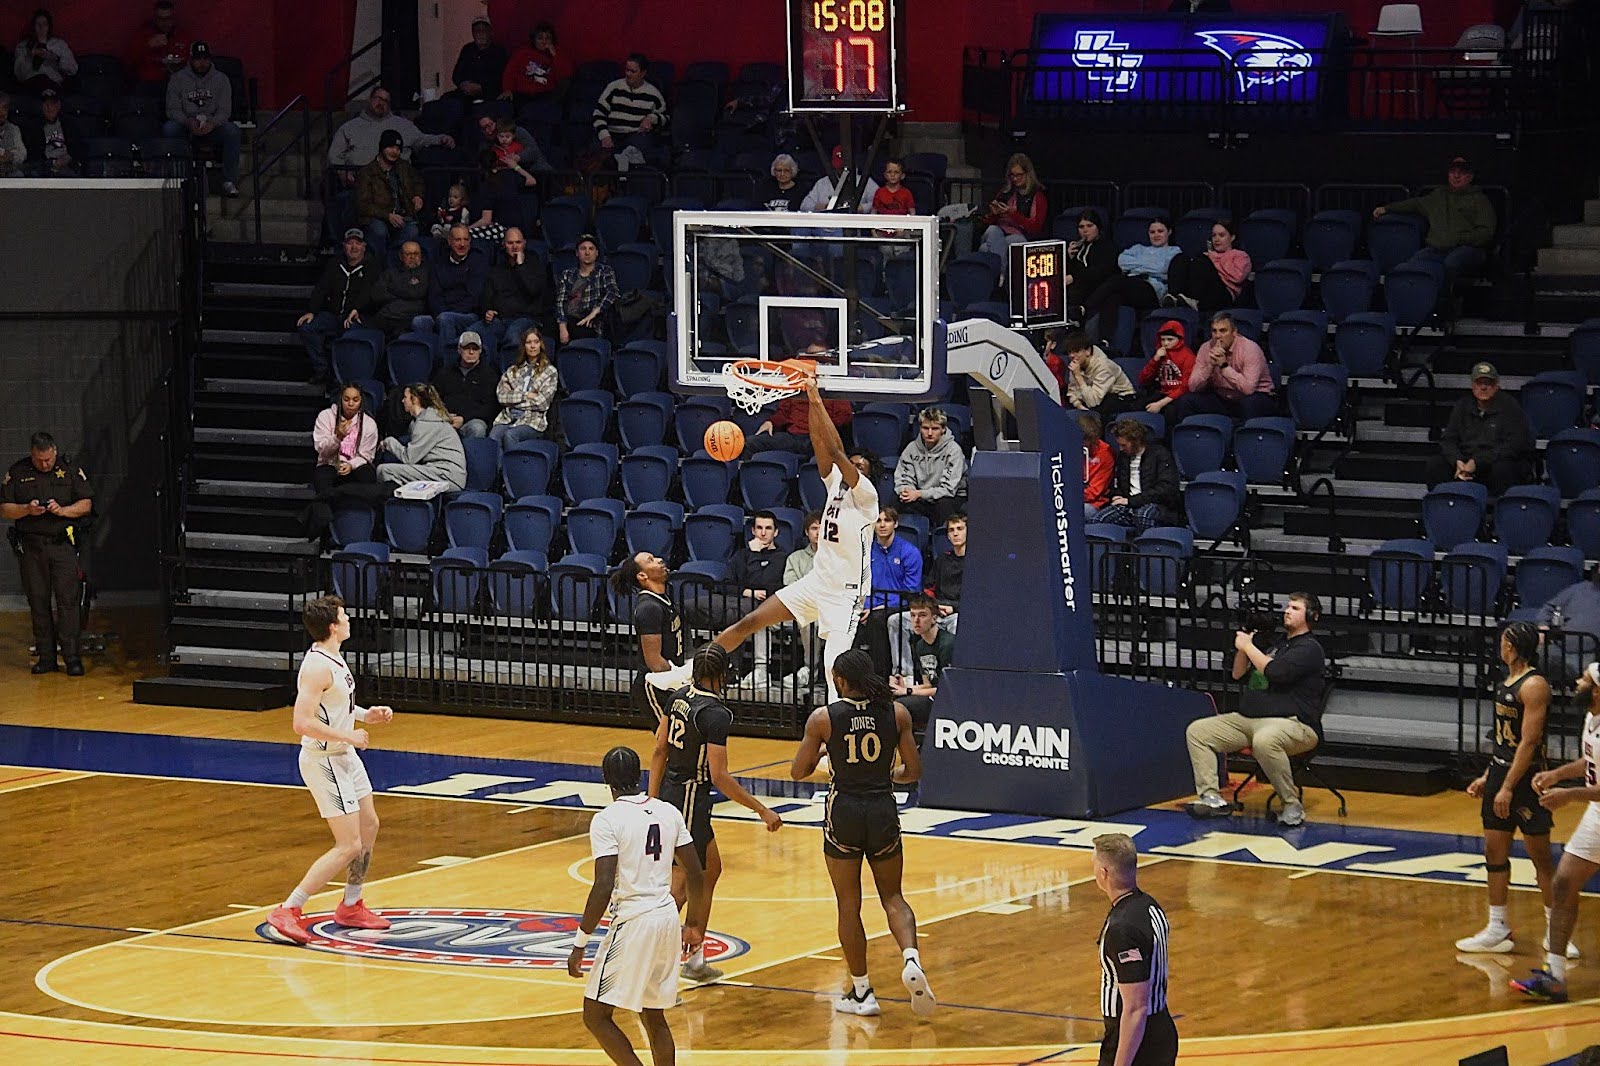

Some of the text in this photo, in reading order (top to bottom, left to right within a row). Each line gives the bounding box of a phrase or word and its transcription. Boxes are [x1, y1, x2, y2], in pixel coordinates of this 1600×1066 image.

[814, 0, 884, 32] 15:08
[836, 37, 875, 93] 17
[1033, 282, 1049, 310] 17
[686, 375, 711, 383] SPALDING
[823, 519, 840, 543] 12
[1050, 453, 1076, 612] TicketSmarter
[668, 714, 686, 750] 12
[849, 716, 876, 732] JONES
[935, 718, 1070, 758] ROMAIN
[843, 732, 881, 764] 10
[982, 752, 1070, 771] CROSS POINTE
[645, 823, 662, 861] 4
